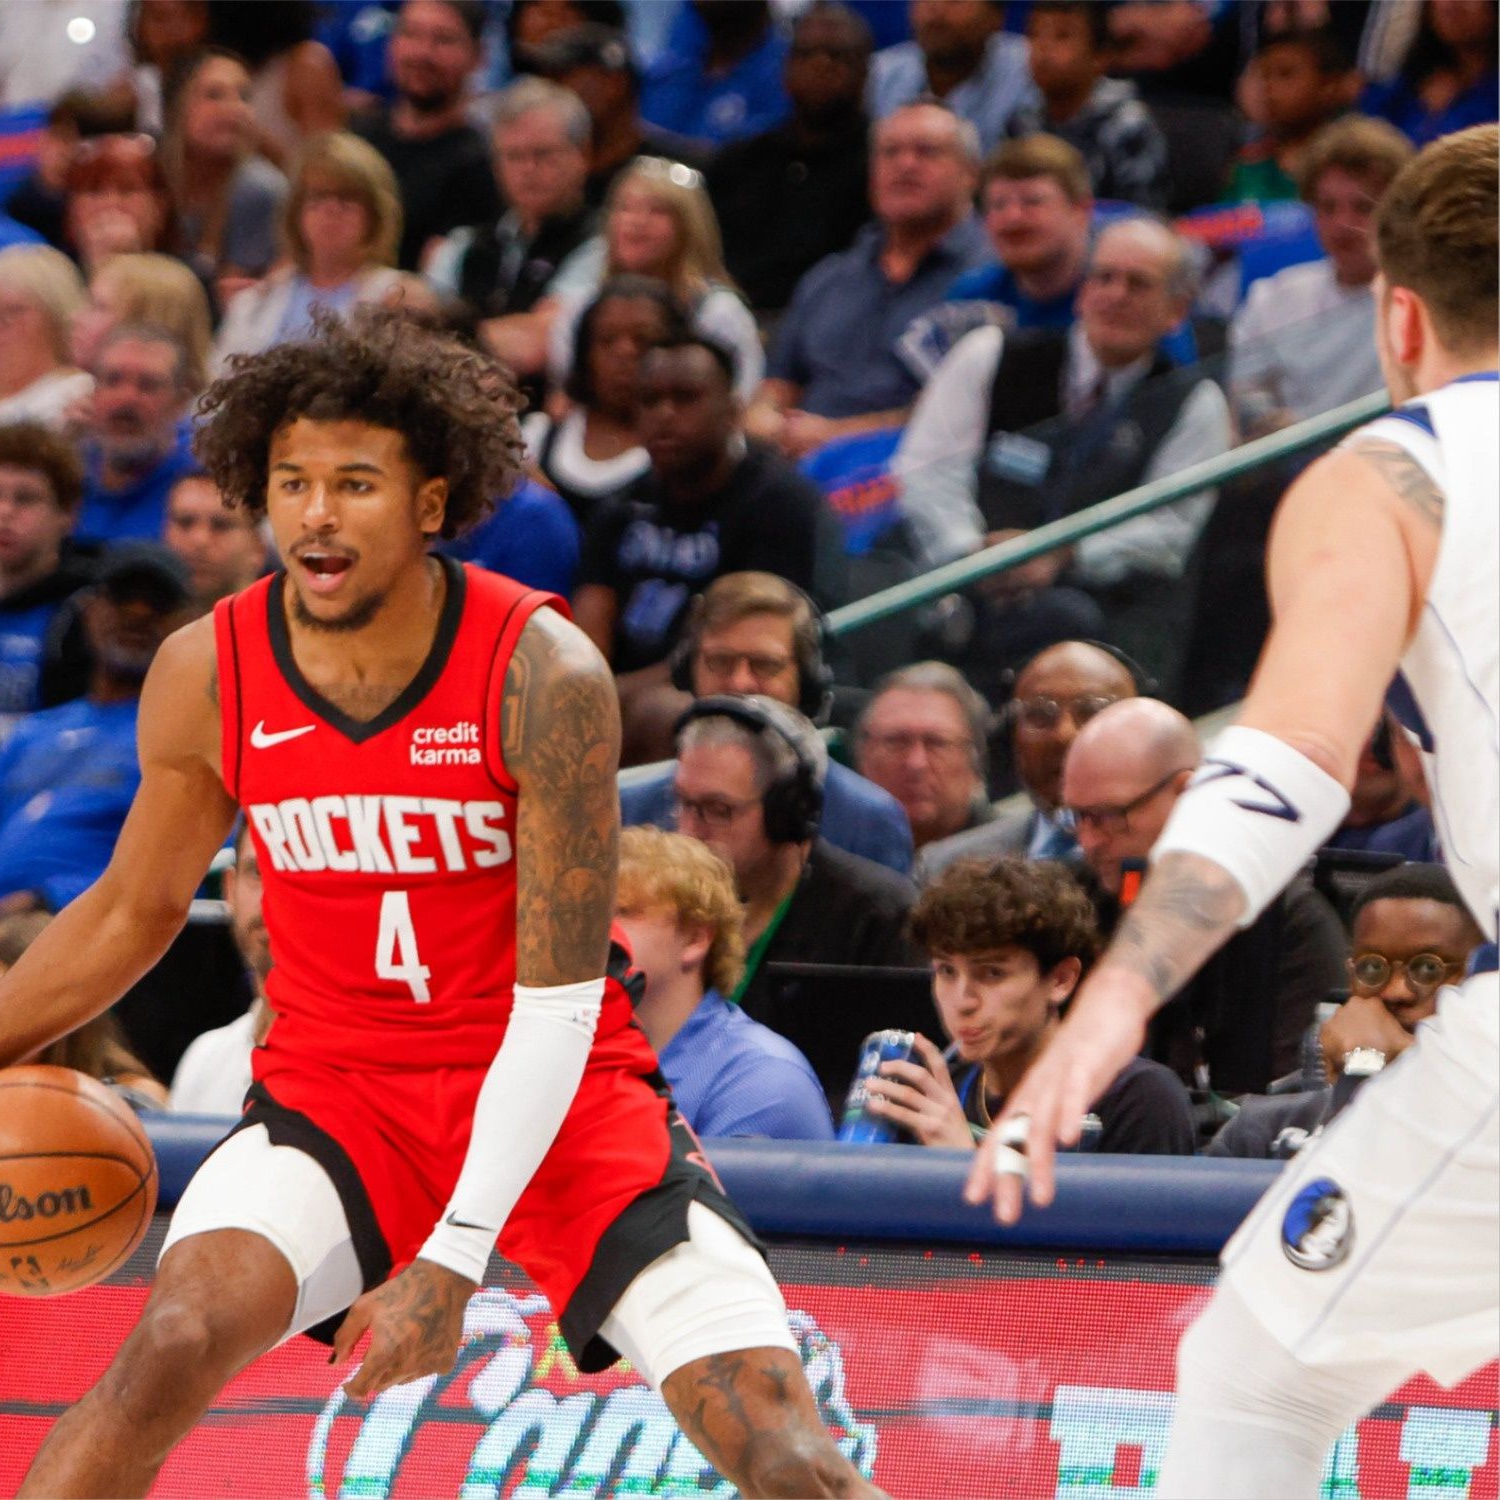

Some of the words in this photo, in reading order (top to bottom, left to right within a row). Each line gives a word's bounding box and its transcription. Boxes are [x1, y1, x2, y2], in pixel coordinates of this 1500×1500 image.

[409, 744, 482, 766] karma
[411, 721, 480, 744] credit
[248, 793, 513, 874] ROCKETS
[374, 890, 432, 1004] 4
